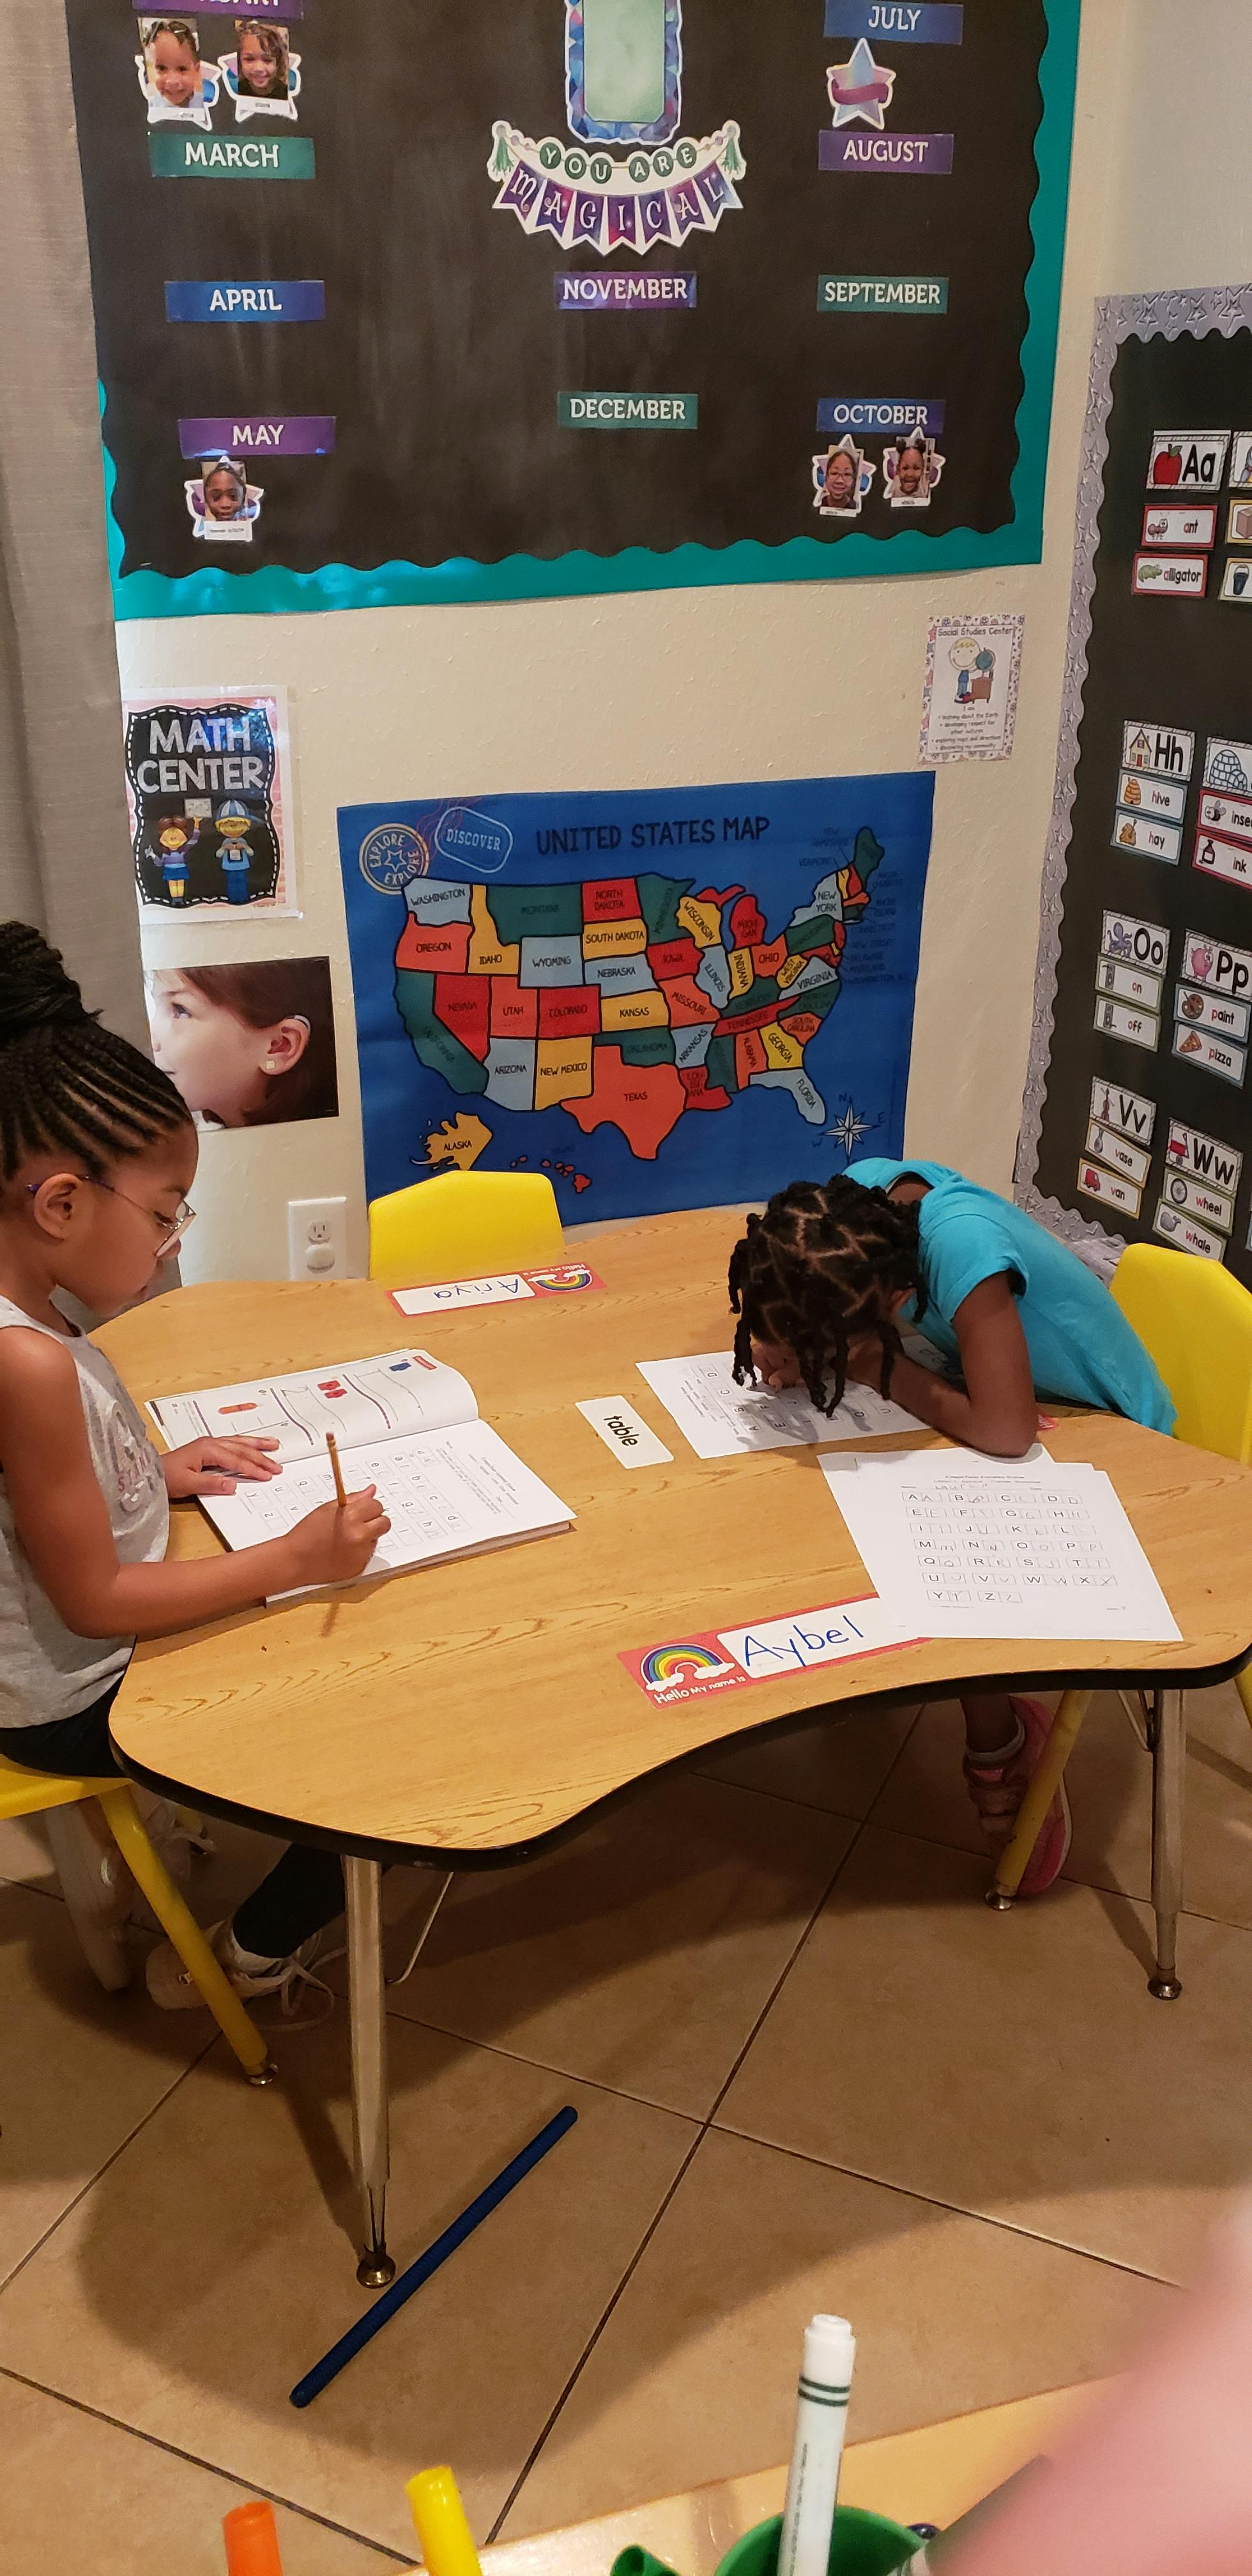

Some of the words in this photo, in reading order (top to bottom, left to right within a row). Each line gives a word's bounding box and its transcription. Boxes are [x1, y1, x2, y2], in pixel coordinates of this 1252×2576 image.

[868, 6, 921, 31] JULY
[185, 142, 279, 167] MARCH
[843, 140, 928, 162] AUGUST
[546, 149, 607, 180] YOU
[634, 147, 693, 177] ARE
[510, 169, 724, 231] MAGICAL
[210, 289, 282, 310] APRIL
[563, 279, 688, 300] NOVEMBER
[825, 282, 940, 304] SEPTEMBER
[570, 399, 686, 420] DECEMBER
[834, 404, 928, 425] OCTOBER
[232, 425, 284, 446] MAY
[1182, 444, 1217, 482] Aa
[1183, 519, 1198, 534] ant
[1163, 567, 1202, 585] alligator
[149, 718, 251, 754] MATH
[1154, 733, 1184, 772] Hh
[137, 756, 264, 793] CENTER
[1152, 790, 1170, 806] hive
[1232, 810, 1252, 827] inse
[446, 829, 501, 850] DISCOVER
[537, 825, 621, 855] UNITED
[631, 818, 715, 848] STATES
[722, 815, 770, 841] MAP
[1148, 831, 1165, 850] hay
[369, 834, 406, 868] EXPLORE
[385, 850, 421, 884] EXPLORE
[1232, 857, 1247, 873] ink
[411, 889, 465, 906] WASHINGTON
[594, 900, 624, 910] DAKOTA
[595, 889, 623, 900] NORTH
[818, 891, 836, 900] NEW
[816, 903, 836, 912] YORK
[683, 901, 715, 941] WISCONSIN
[416, 942, 451, 953] OREGON
[586, 933, 613, 944] SOUTH
[615, 930, 645, 942] DAKOTA
[1134, 928, 1163, 965] Oo
[479, 954, 502, 965] IDAHO
[531, 956, 572, 969] WYOMING
[758, 952, 779, 963] OHIO
[597, 966, 636, 978] NEBRASKA
[704, 963, 726, 992] ILLINOIS
[733, 954, 749, 988] INDIANA
[797, 970, 833, 990] VIRGINIA
[1216, 951, 1249, 994] Pp
[1132, 981, 1142, 994] on
[448, 1001, 477, 1011] NEVADA
[503, 1007, 523, 1016] UTAH
[549, 1005, 588, 1017] COLORADO
[620, 1007, 650, 1018] KANSAS
[671, 991, 706, 1015] MISSOURI
[1127, 1018, 1142, 1033] off
[1211, 1008, 1235, 1025] paint
[787, 1023, 815, 1032] CAROLINA
[679, 1029, 708, 1062] ARKANSAS
[744, 1037, 757, 1068] ALABAMA
[768, 1032, 792, 1063] GEORGIA
[1209, 1048, 1232, 1067] pizza
[494, 1065, 527, 1075] ARIZONA
[540, 1067, 558, 1077] NEW
[561, 1062, 588, 1074] MEXICO
[623, 1091, 648, 1102] TEXAS
[796, 1078, 816, 1109] FLORIDA
[839, 1092, 848, 1102] N
[878, 1112, 885, 1124] E
[1119, 1094, 1147, 1133] Vv
[443, 1140, 473, 1151] ALASKA
[1115, 1149, 1133, 1167] vase
[1193, 1138, 1234, 1185] Ww
[1110, 1186, 1125, 1201] van
[1195, 1195, 1222, 1216] wheel
[1186, 1229, 1210, 1254] whale
[562, 1263, 586, 1271] Hello
[434, 1278, 519, 1300] Ariya
[603, 1414, 638, 1447] table
[744, 1614, 864, 1667] Aybel
[653, 1688, 690, 1705] Hello
[690, 1684, 707, 1696] My
[708, 1678, 736, 1690] name
[737, 1675, 746, 1683] is
